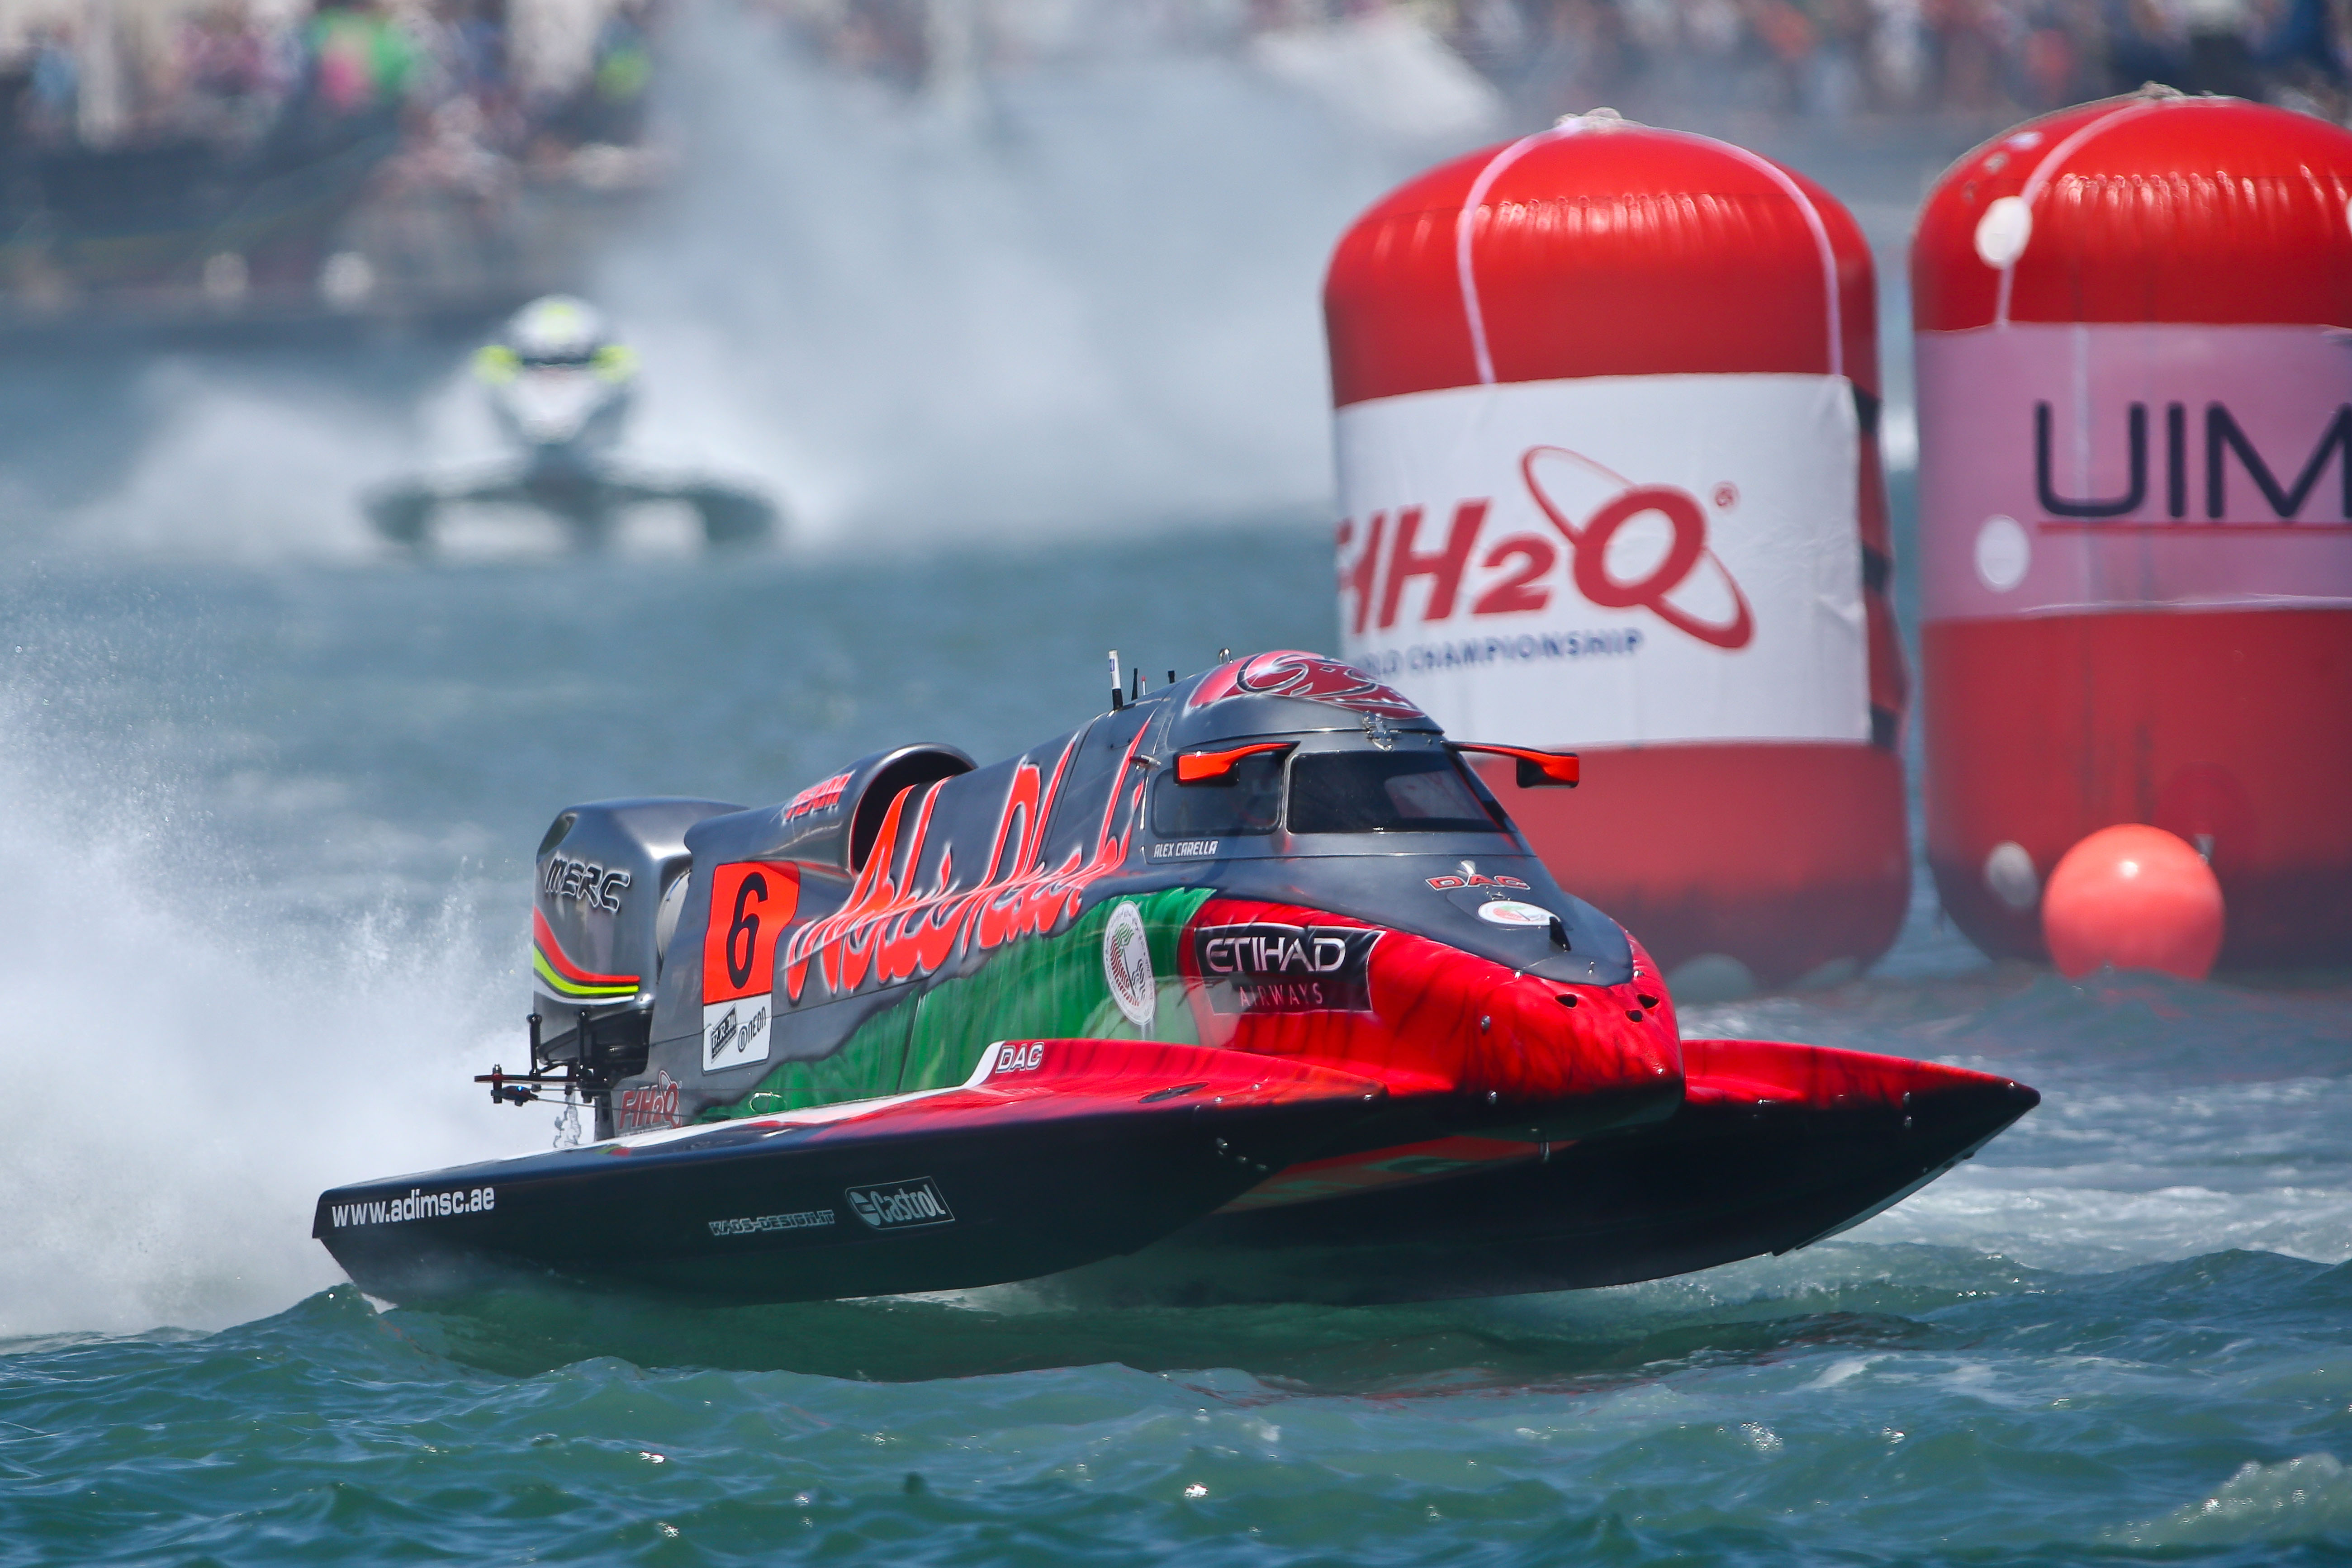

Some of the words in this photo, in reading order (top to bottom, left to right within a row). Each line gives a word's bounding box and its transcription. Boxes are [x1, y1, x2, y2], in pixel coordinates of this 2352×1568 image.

[2036, 400, 2352, 518] UIM
[1404, 628, 1642, 672] CHAMPIONSHIP
[1153, 842, 1175, 858] ALEX
[1176, 840, 1219, 857] CARELLA
[545, 857, 631, 913] MERC
[1426, 874, 1531, 891] DAC
[727, 872, 768, 989] 6
[1206, 936, 1346, 972] ETIHAD
[1239, 982, 1323, 1008] AIRWAYS
[996, 1042, 1044, 1074] DAC
[332, 1187, 495, 1227] www.adimsc.ae
[870, 1184, 946, 1222] Castrol
